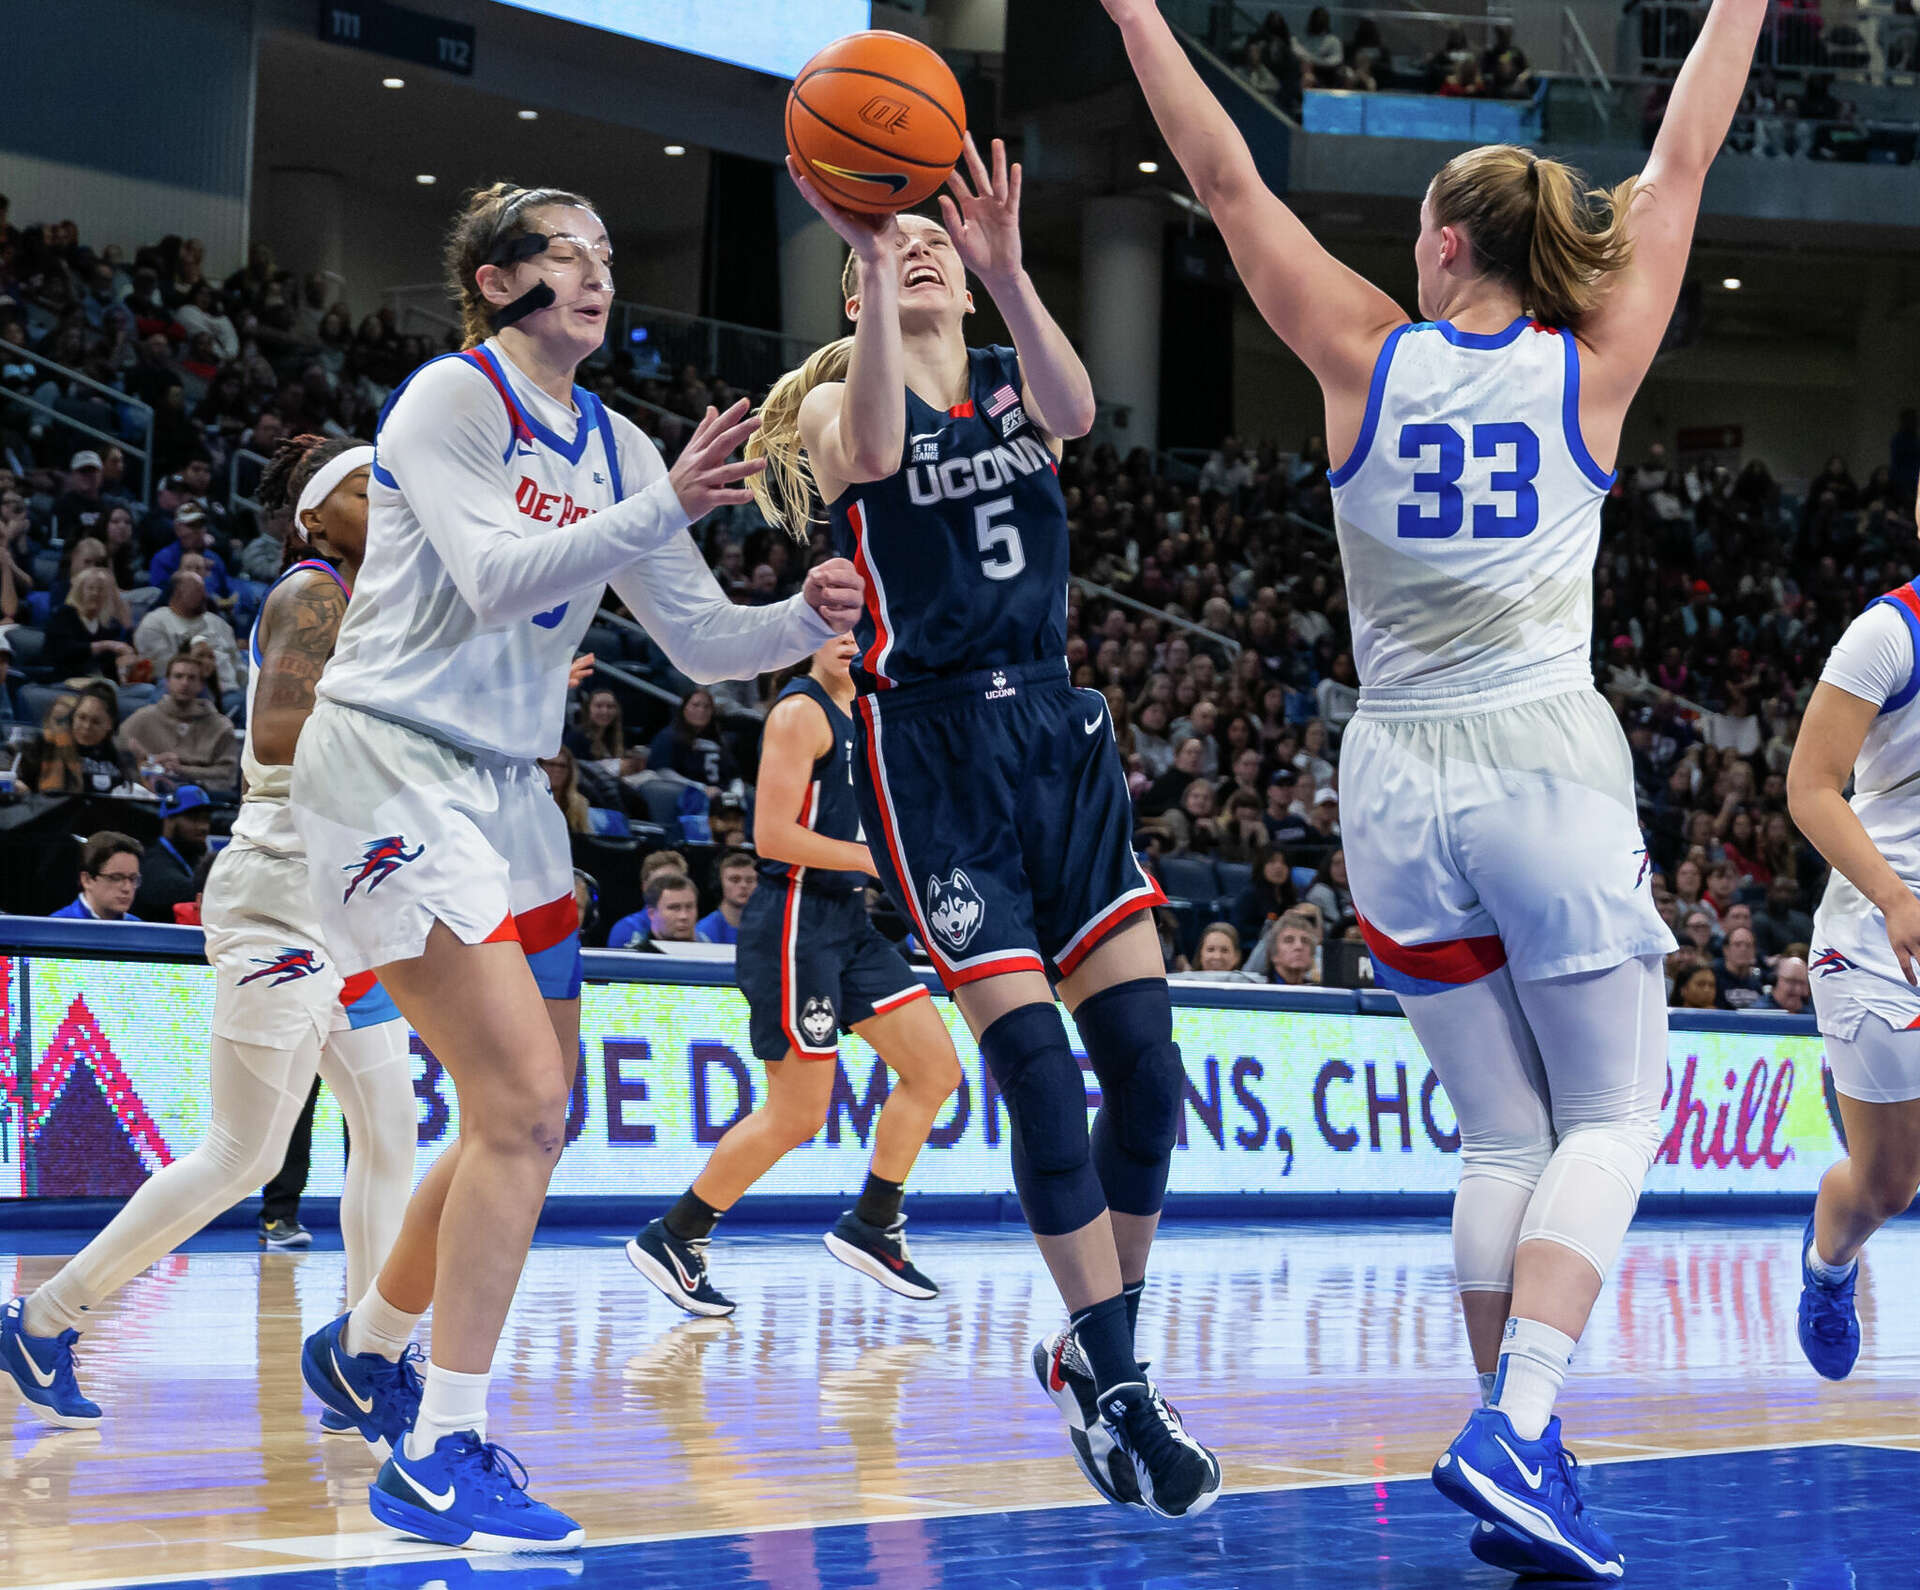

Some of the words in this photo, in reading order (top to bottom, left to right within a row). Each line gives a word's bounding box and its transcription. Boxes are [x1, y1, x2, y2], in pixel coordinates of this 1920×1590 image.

[332, 9, 361, 39] 111
[437, 36, 470, 67] 112
[1002, 407, 1022, 424] BIG
[911, 451, 940, 463] HANGE
[923, 442, 939, 452] THE
[906, 435, 1051, 506] UCONN
[1397, 421, 1541, 539] 33
[973, 495, 1026, 580] 5
[985, 687, 1016, 700] UCONN
[704, 752, 721, 783] 5
[1652, 1055, 1796, 1169] hill
